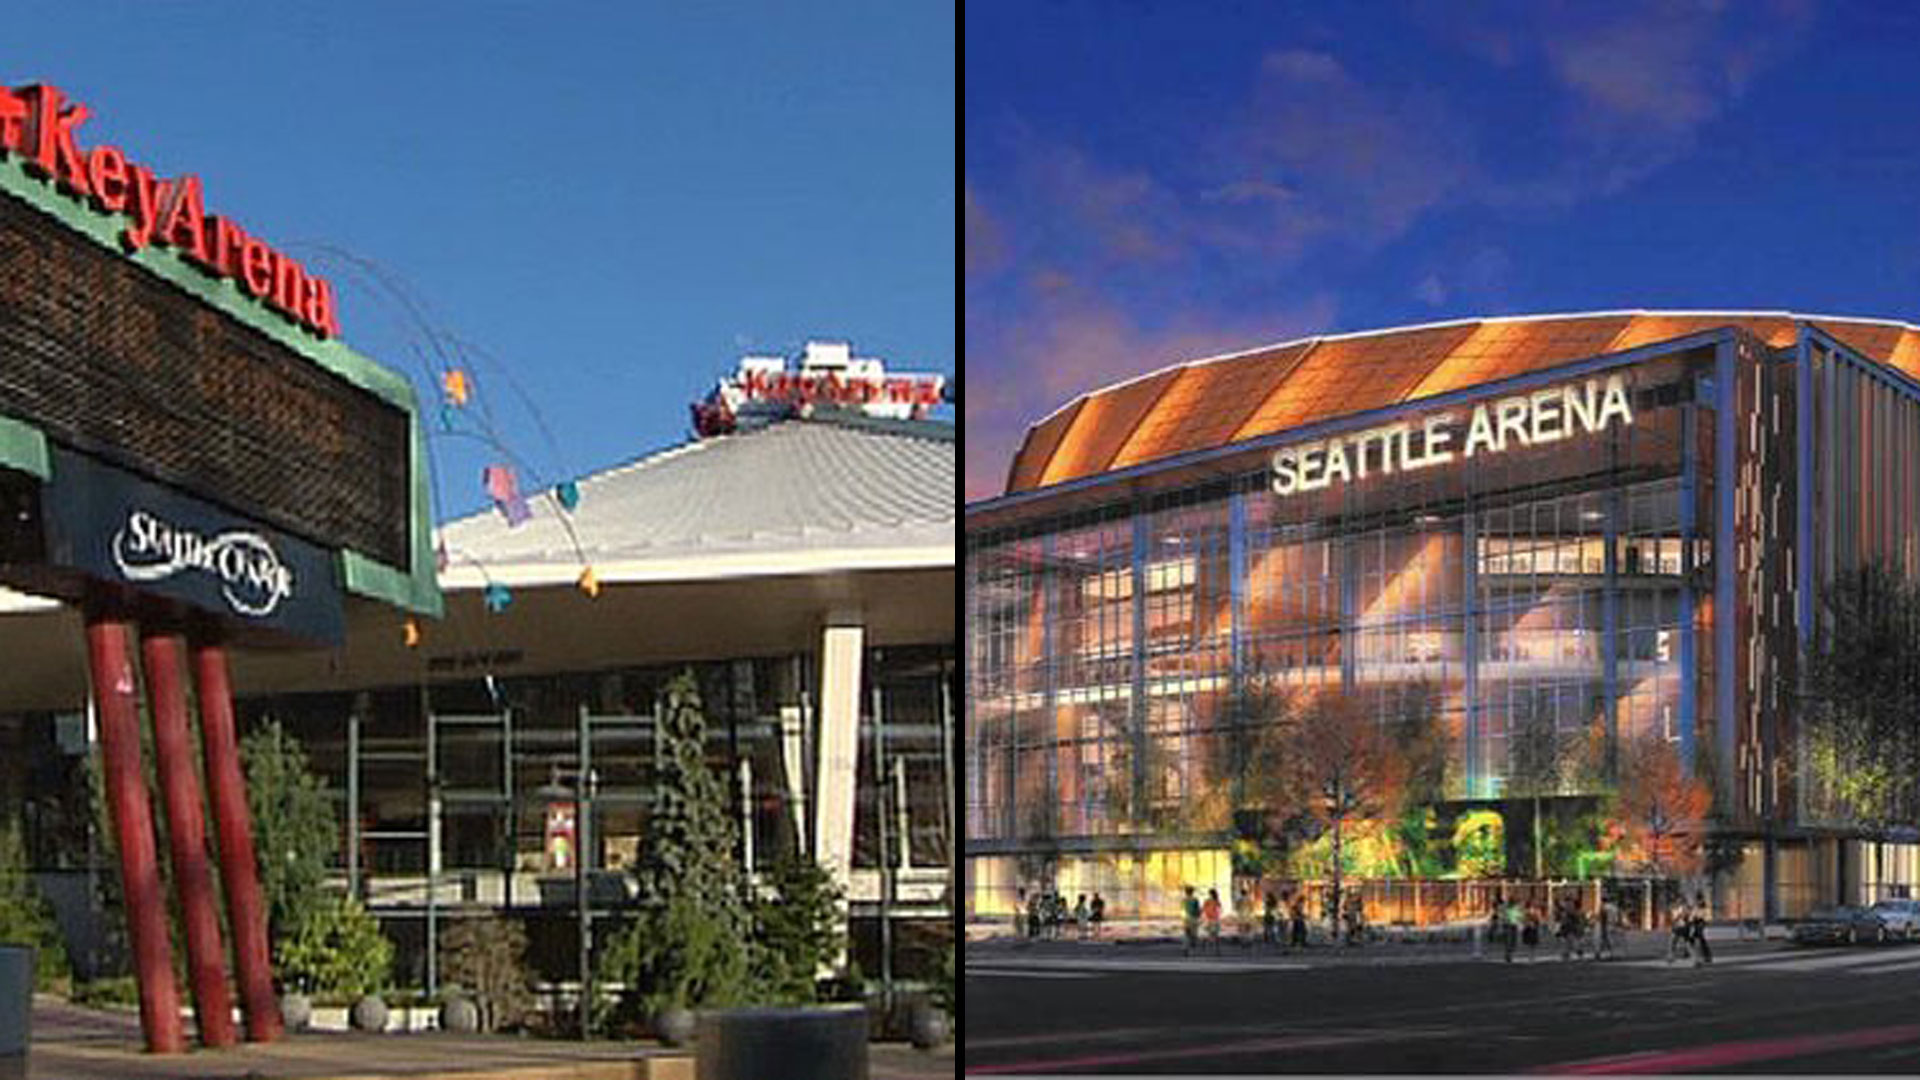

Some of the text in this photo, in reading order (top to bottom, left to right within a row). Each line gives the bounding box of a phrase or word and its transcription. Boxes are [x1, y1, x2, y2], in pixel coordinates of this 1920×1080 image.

[37, 84, 340, 337] KeyArena
[1272, 374, 1632, 494] SEATTLE ARENA
